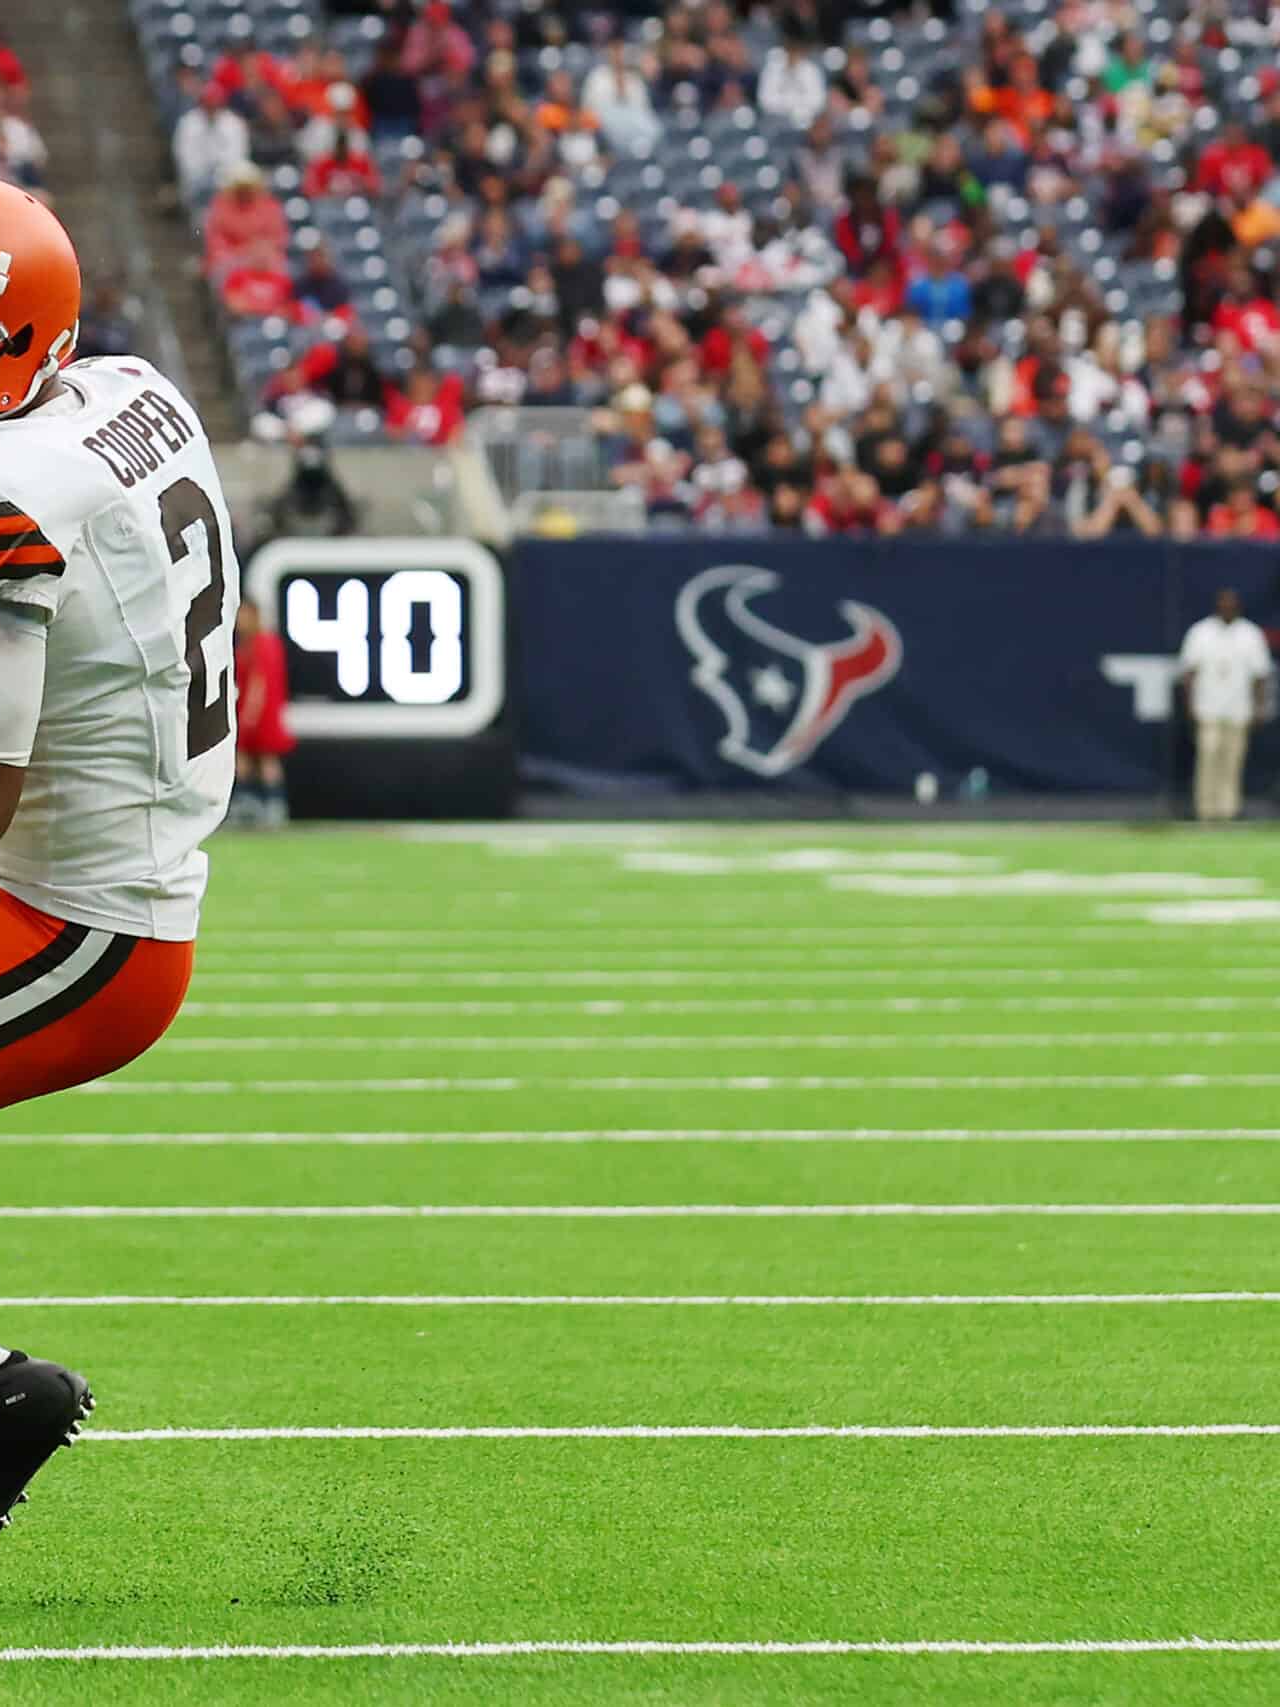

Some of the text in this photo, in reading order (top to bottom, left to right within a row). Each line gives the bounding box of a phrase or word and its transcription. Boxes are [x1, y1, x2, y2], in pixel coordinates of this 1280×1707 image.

[82, 390, 194, 488] COOPER
[157, 476, 231, 761] 2
[287, 570, 463, 705] 40
